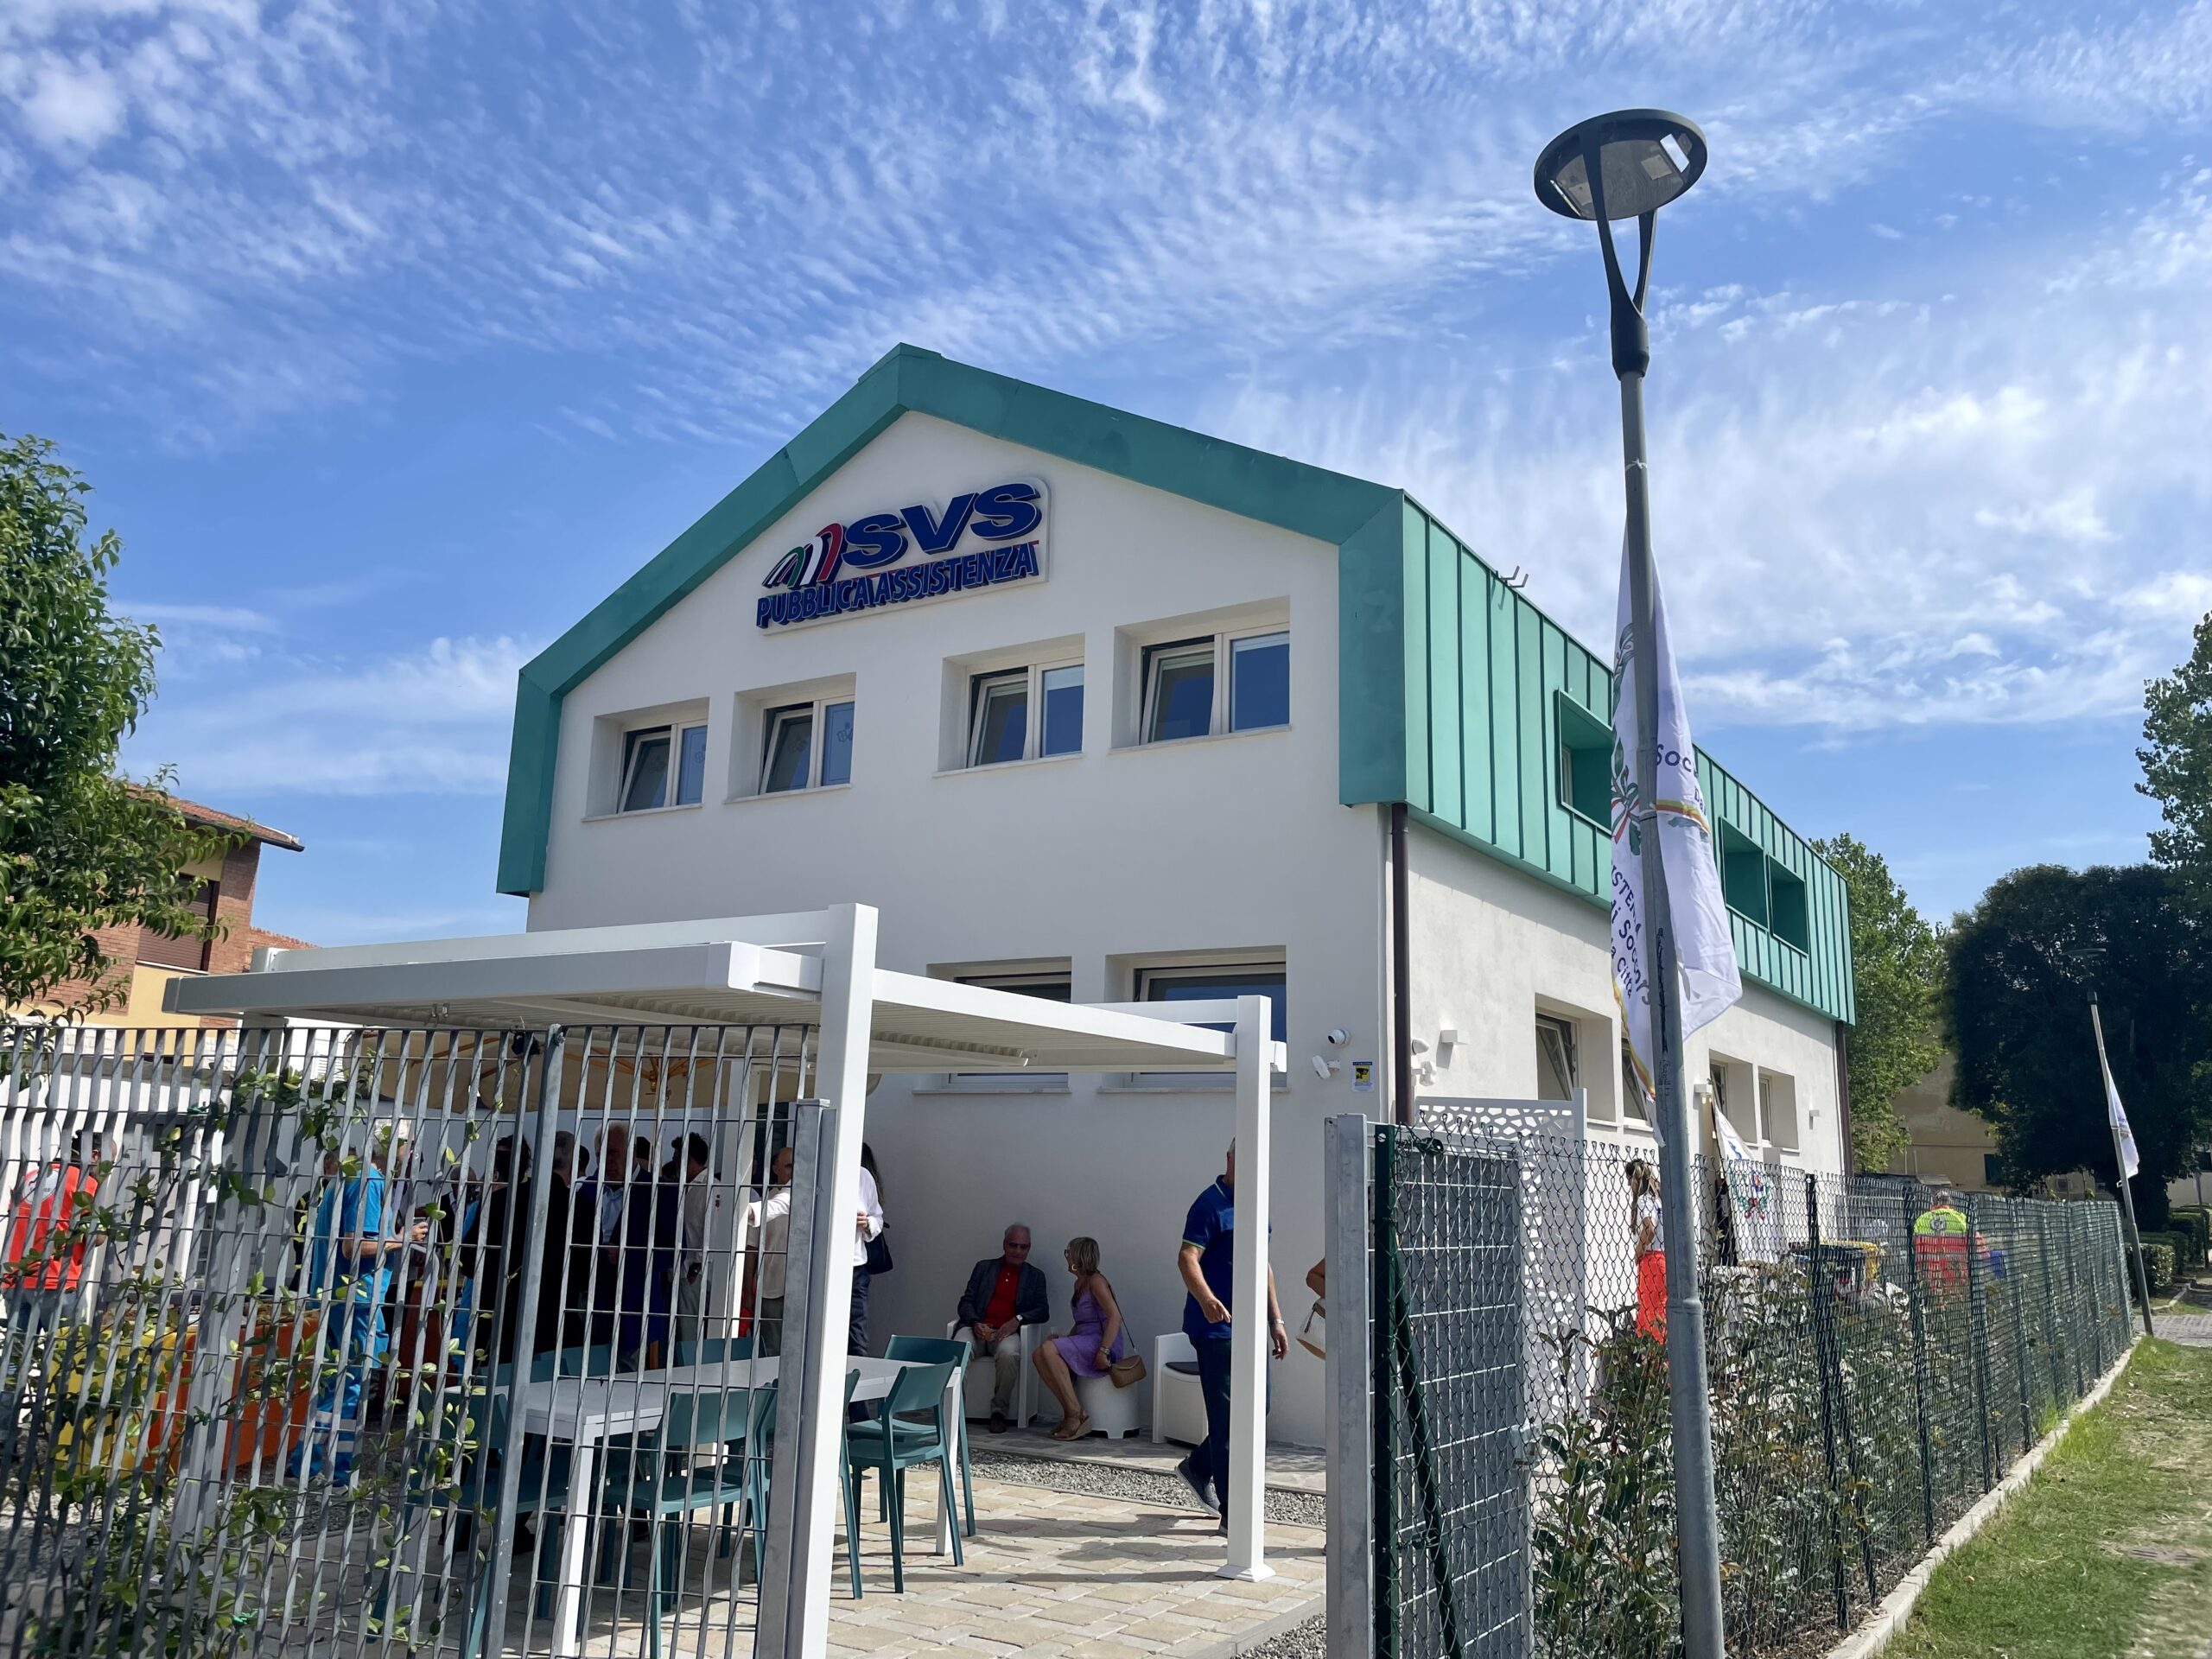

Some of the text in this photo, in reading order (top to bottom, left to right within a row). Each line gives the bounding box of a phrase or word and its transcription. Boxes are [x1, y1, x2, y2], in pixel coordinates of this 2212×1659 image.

[842, 483, 1042, 569] SVS
[756, 543, 1039, 628] PUBBLICA ASSISTENZA
